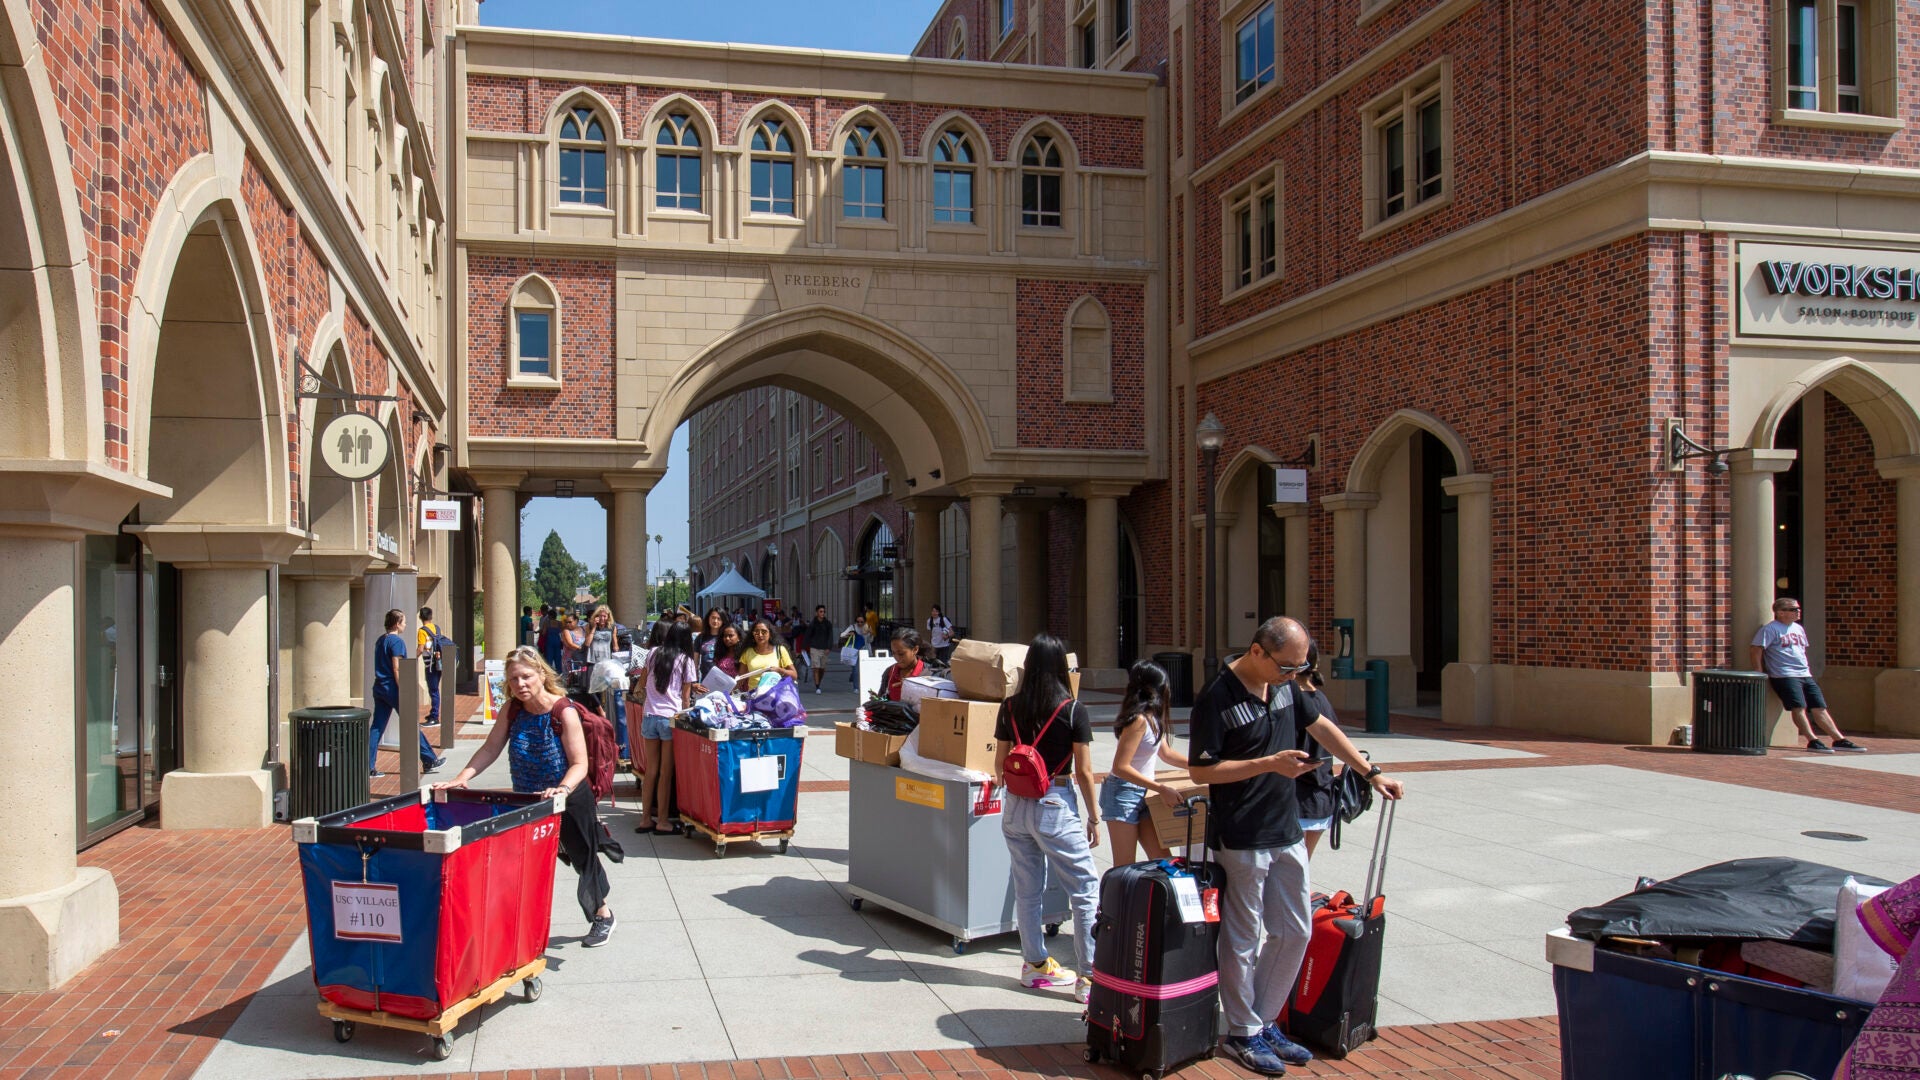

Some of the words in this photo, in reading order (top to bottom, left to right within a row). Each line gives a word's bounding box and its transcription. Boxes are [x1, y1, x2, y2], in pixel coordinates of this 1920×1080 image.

[784, 274, 861, 289] FREEBERG
[1760, 259, 1920, 301] WORKSH
[806, 288, 840, 297] BRIDGE
[533, 822, 555, 841] 257
[335, 895, 353, 905] USC
[356, 896, 398, 907] VILLAGE
[350, 912, 384, 928] #110
[1135, 922, 1145, 969] SIERRA
